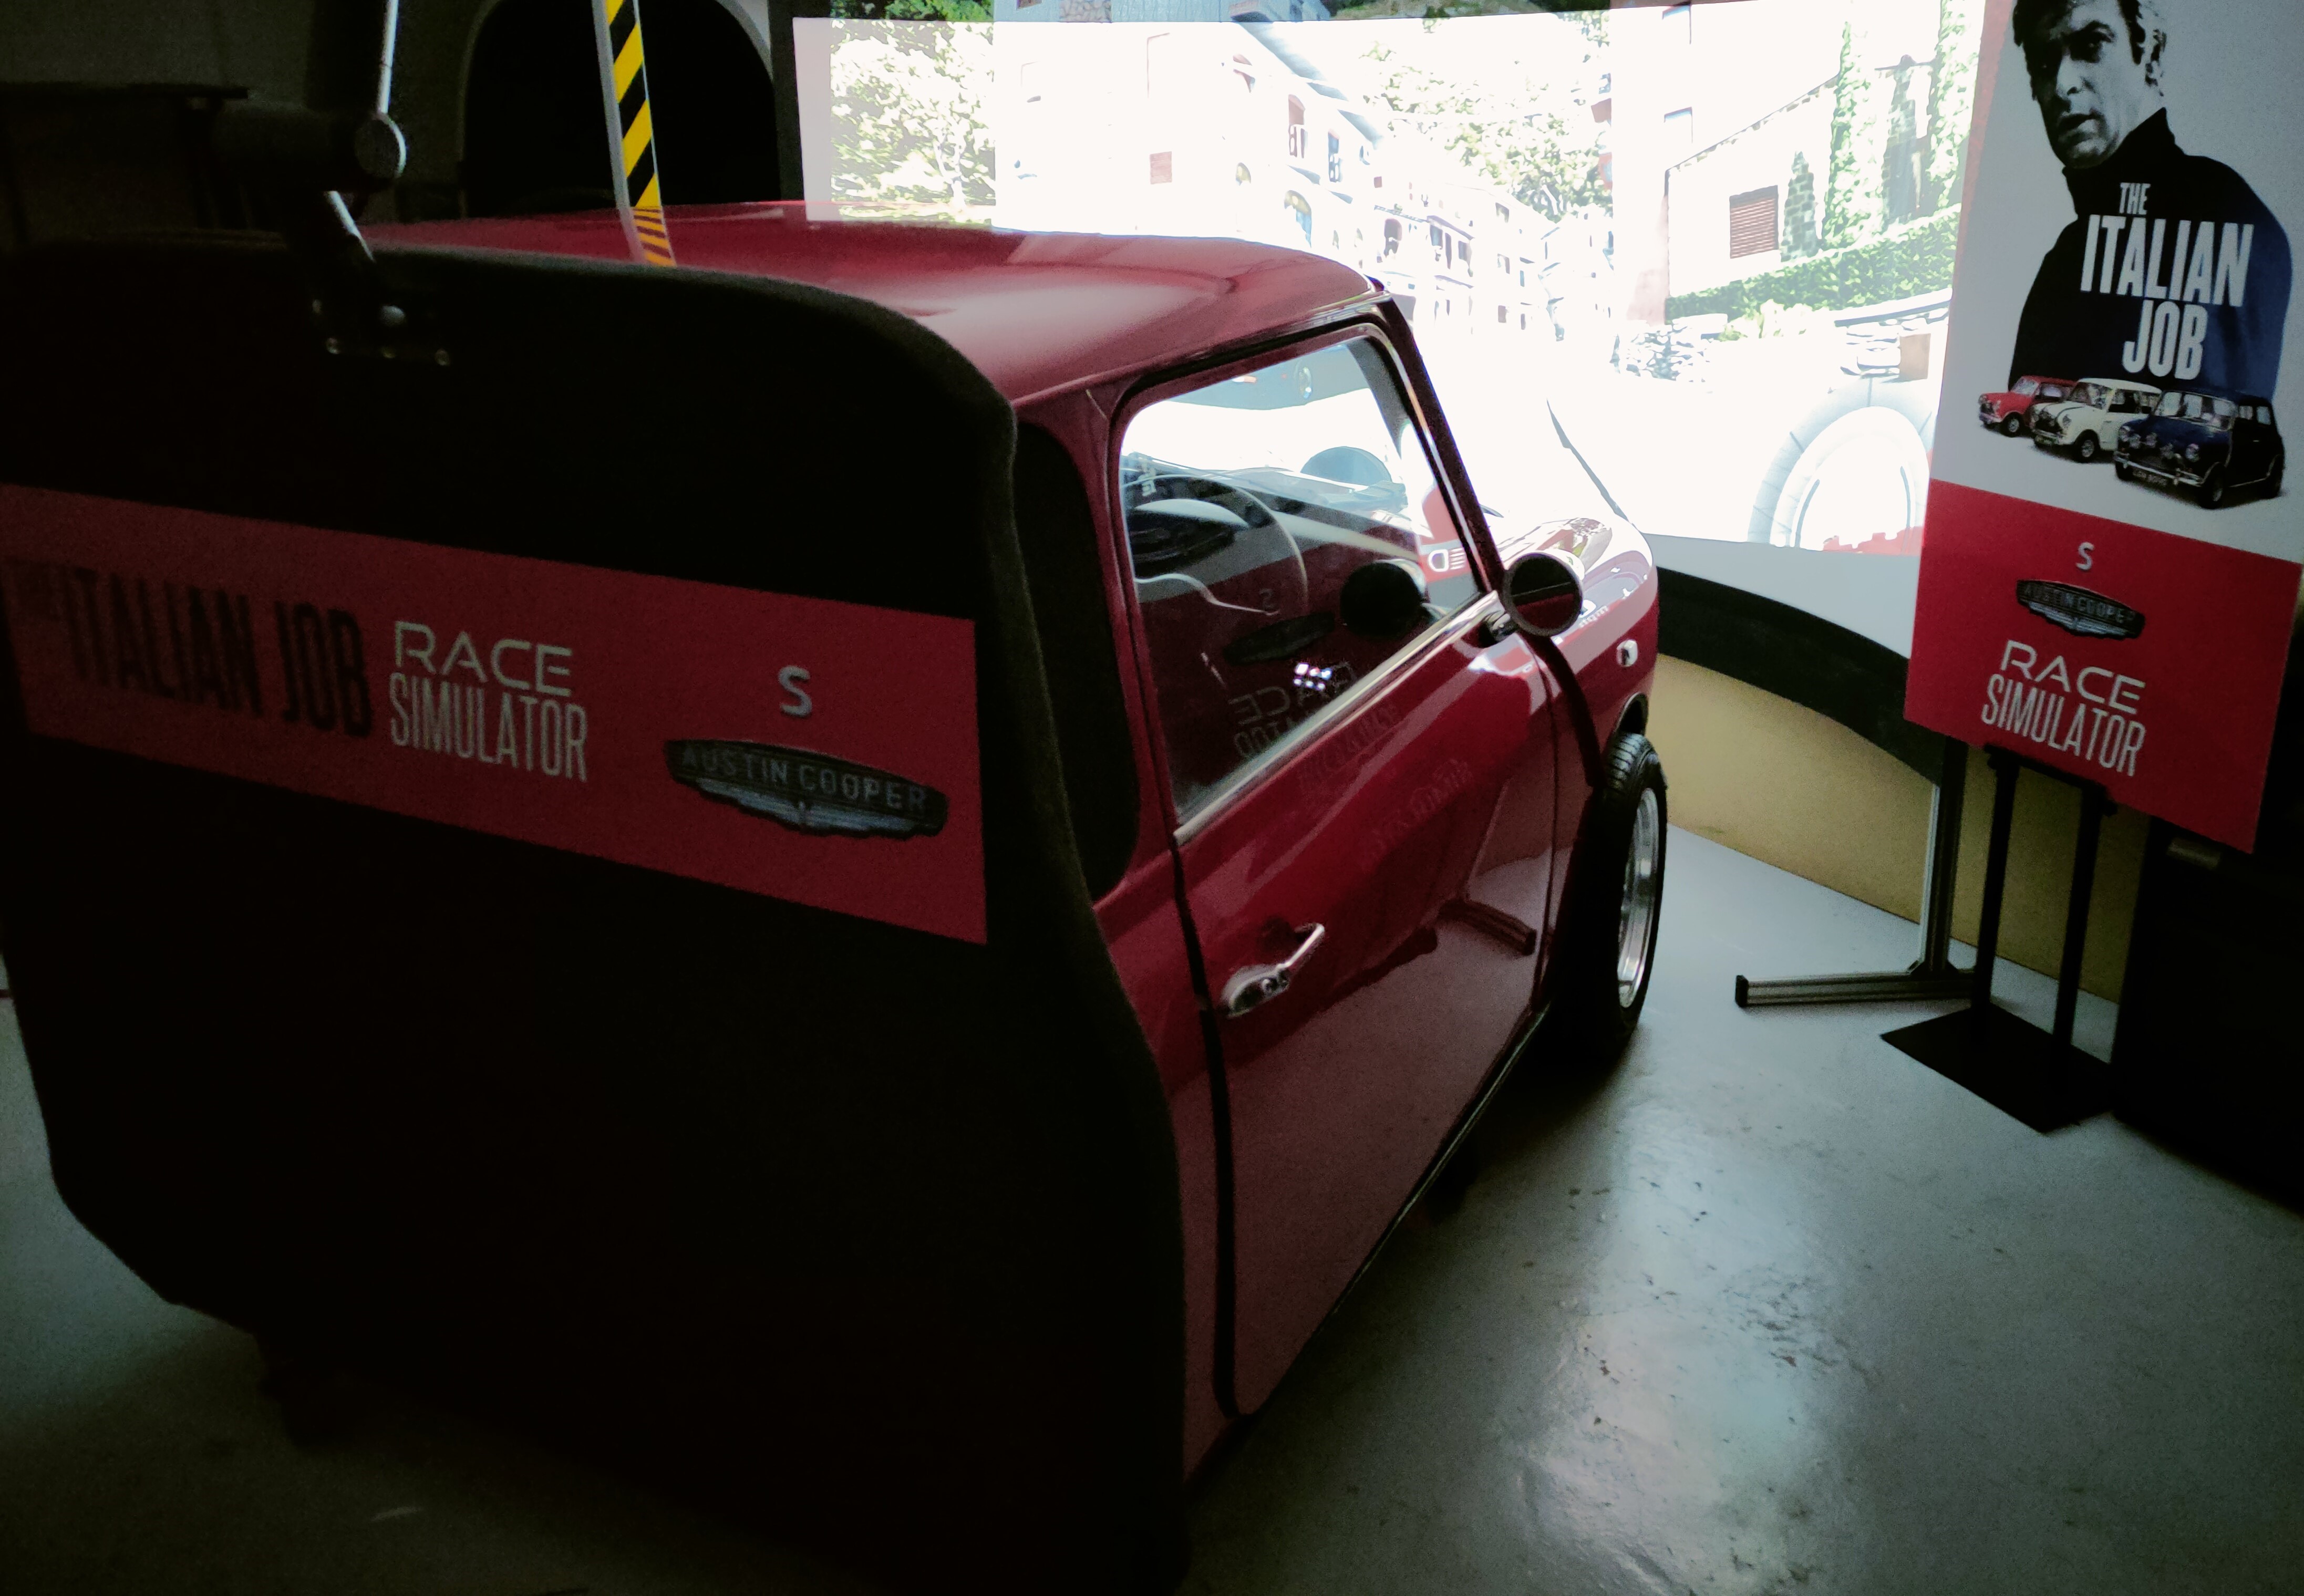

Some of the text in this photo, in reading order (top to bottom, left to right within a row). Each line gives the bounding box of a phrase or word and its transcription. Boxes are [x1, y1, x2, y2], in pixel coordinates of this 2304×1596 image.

[2120, 182, 2151, 215] THE
[2080, 214, 2254, 307] ITALIAN
[2122, 299, 2208, 380] JOB
[2076, 542, 2094, 571] S
[274, 601, 372, 737] JOB
[395, 620, 573, 697] RACE
[778, 665, 813, 718] S
[2000, 640, 2146, 714] RACE
[389, 672, 588, 782] SIMULATOR
[1981, 673, 2146, 777] SIMULATOR
[684, 742, 928, 814] AUSTIN COOPER
